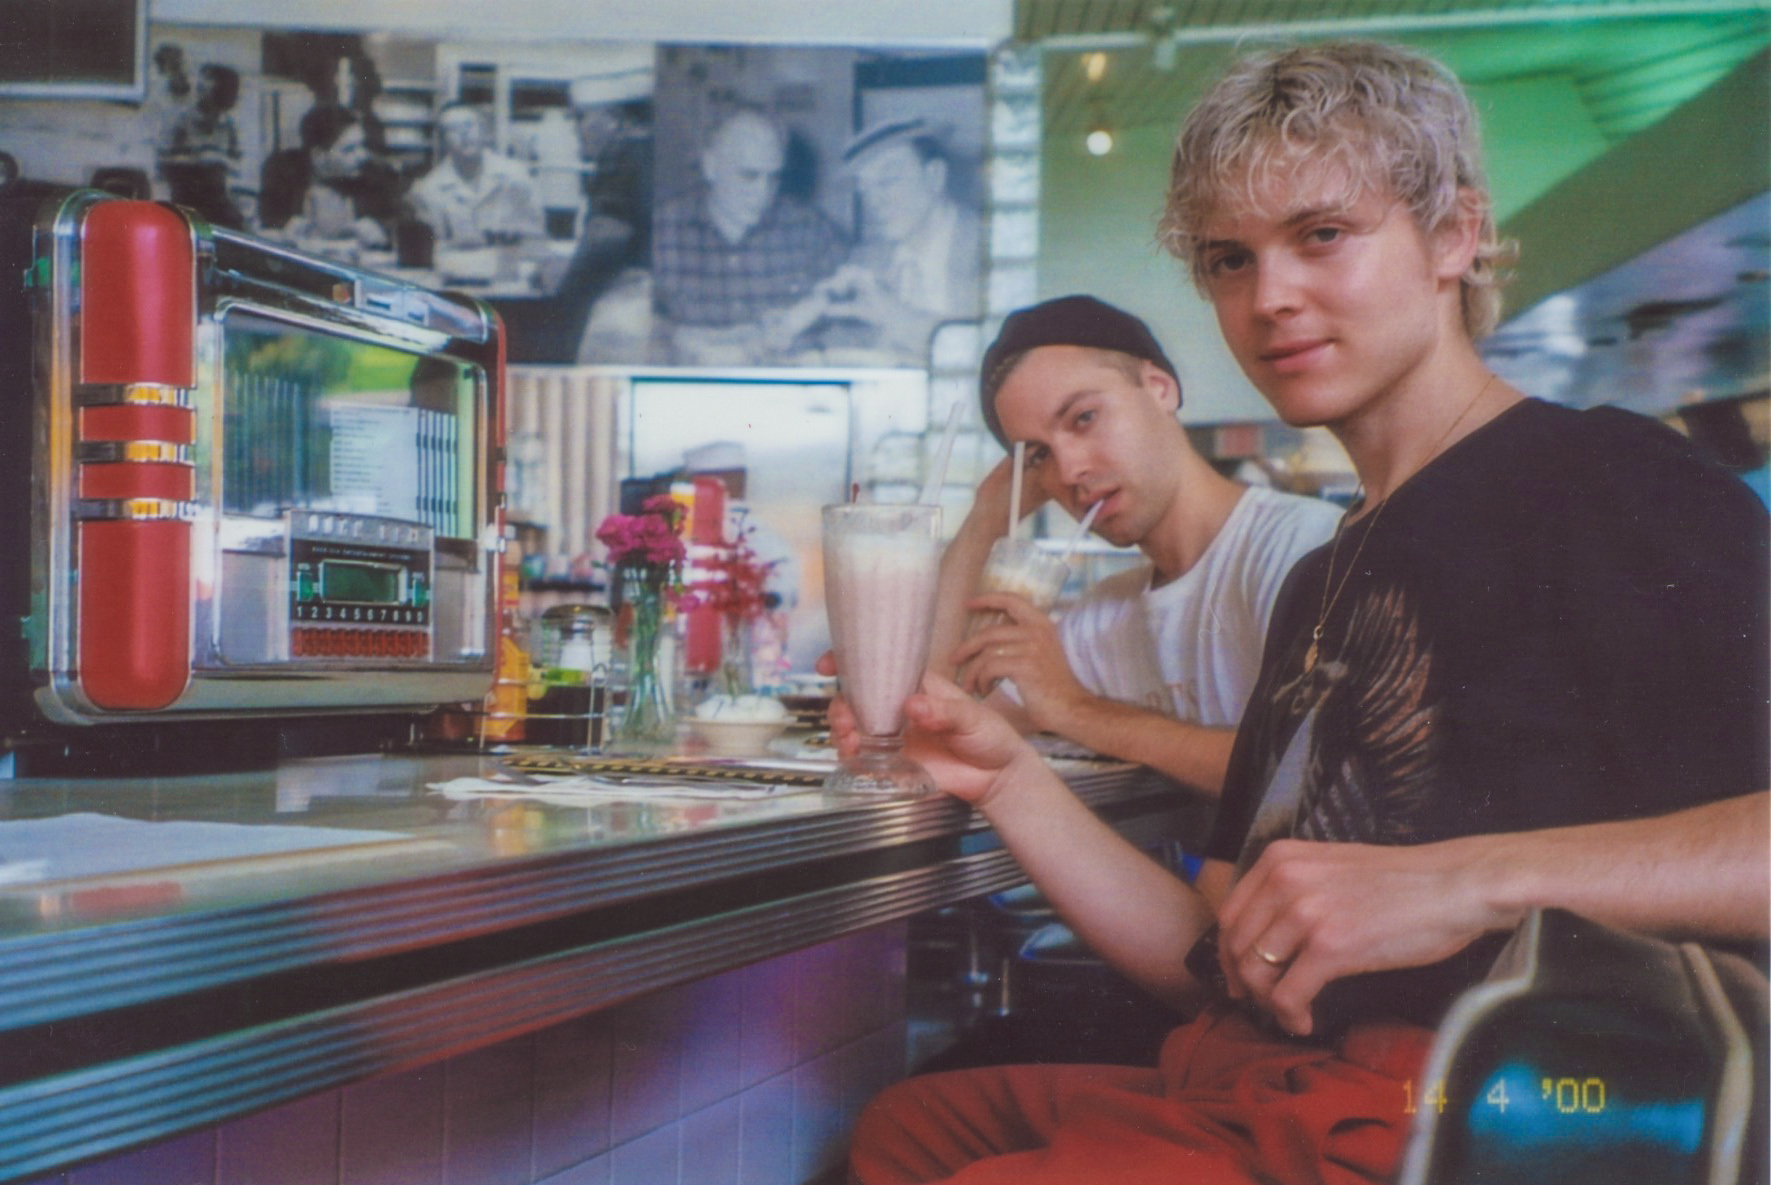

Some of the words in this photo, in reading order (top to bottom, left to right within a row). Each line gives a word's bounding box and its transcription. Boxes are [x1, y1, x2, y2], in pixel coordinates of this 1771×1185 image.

[297, 606, 302, 617] 1
[311, 606, 318, 618] 2
[325, 607, 332, 619] 3
[340, 607, 346, 619] 4
[354, 608, 360, 620] 5
[367, 609, 373, 621] 6
[381, 609, 387, 621] 7
[393, 610, 399, 621] 8
[406, 611, 412, 622] 9
